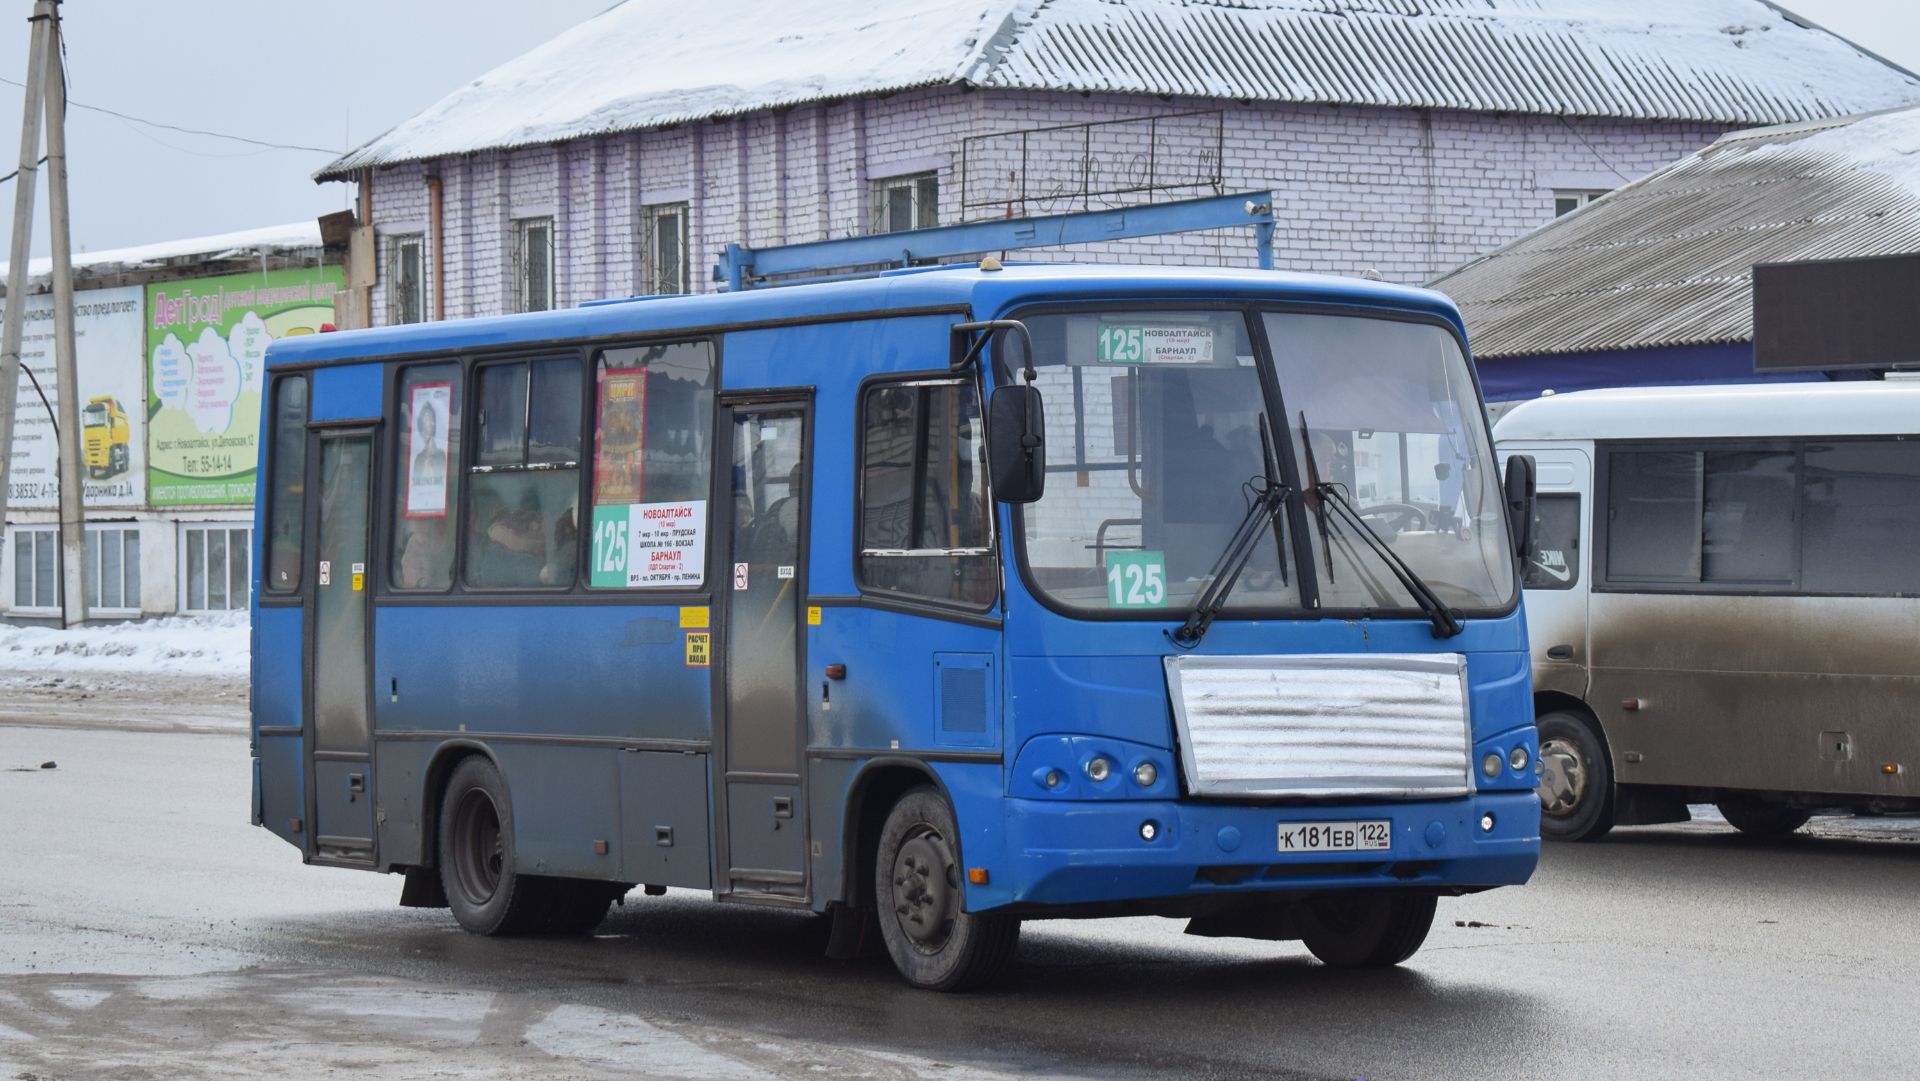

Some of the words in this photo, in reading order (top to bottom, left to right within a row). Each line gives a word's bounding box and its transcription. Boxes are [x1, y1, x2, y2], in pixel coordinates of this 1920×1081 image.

[1101, 328, 1141, 361] 125
[1155, 347, 1197, 355] БАРНАУЛ
[201, 454, 232, 472] 55-14-14
[643, 506, 692, 519] НОВОАЛТАЙСК
[672, 528, 696, 537] ПРУДСКАЯ
[594, 520, 627, 572] 125
[675, 539, 694, 547] ВОКЗАЛ
[651, 550, 682, 561] БАРНАУЛ
[650, 573, 671, 581] ОКТЯБРЯ
[1108, 563, 1164, 604] 125
[688, 634, 708, 643] РАСЧЕТ
[692, 645, 704, 653] ПРИ
[688, 654, 707, 664] ВХОДЕ
[1359, 824, 1385, 841] 122
